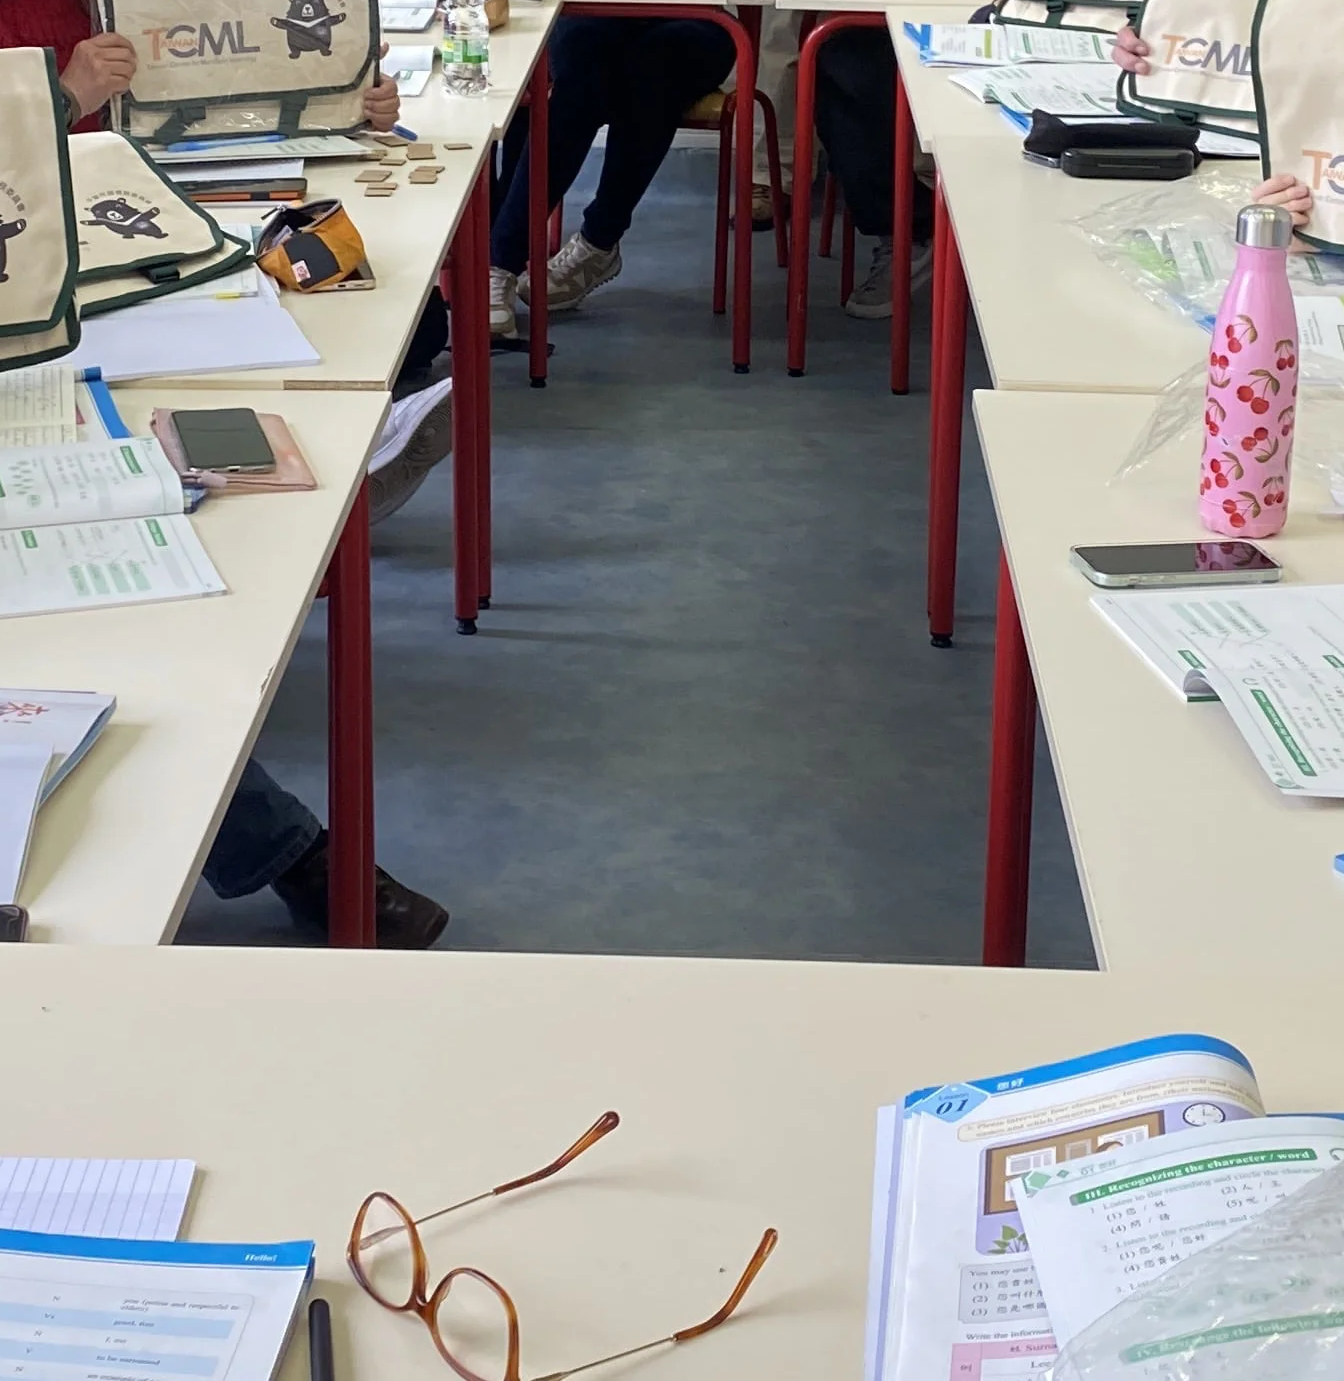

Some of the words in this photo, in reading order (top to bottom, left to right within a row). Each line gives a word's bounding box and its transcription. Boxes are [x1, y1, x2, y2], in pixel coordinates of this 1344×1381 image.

[142, 21, 261, 61] TCML
[936, 1099, 968, 1115] 01
[1108, 1169, 1183, 1194] Recognizing
[1185, 1163, 1204, 1176] the
[1207, 1153, 1266, 1170] character
[1276, 1150, 1310, 1161] word
